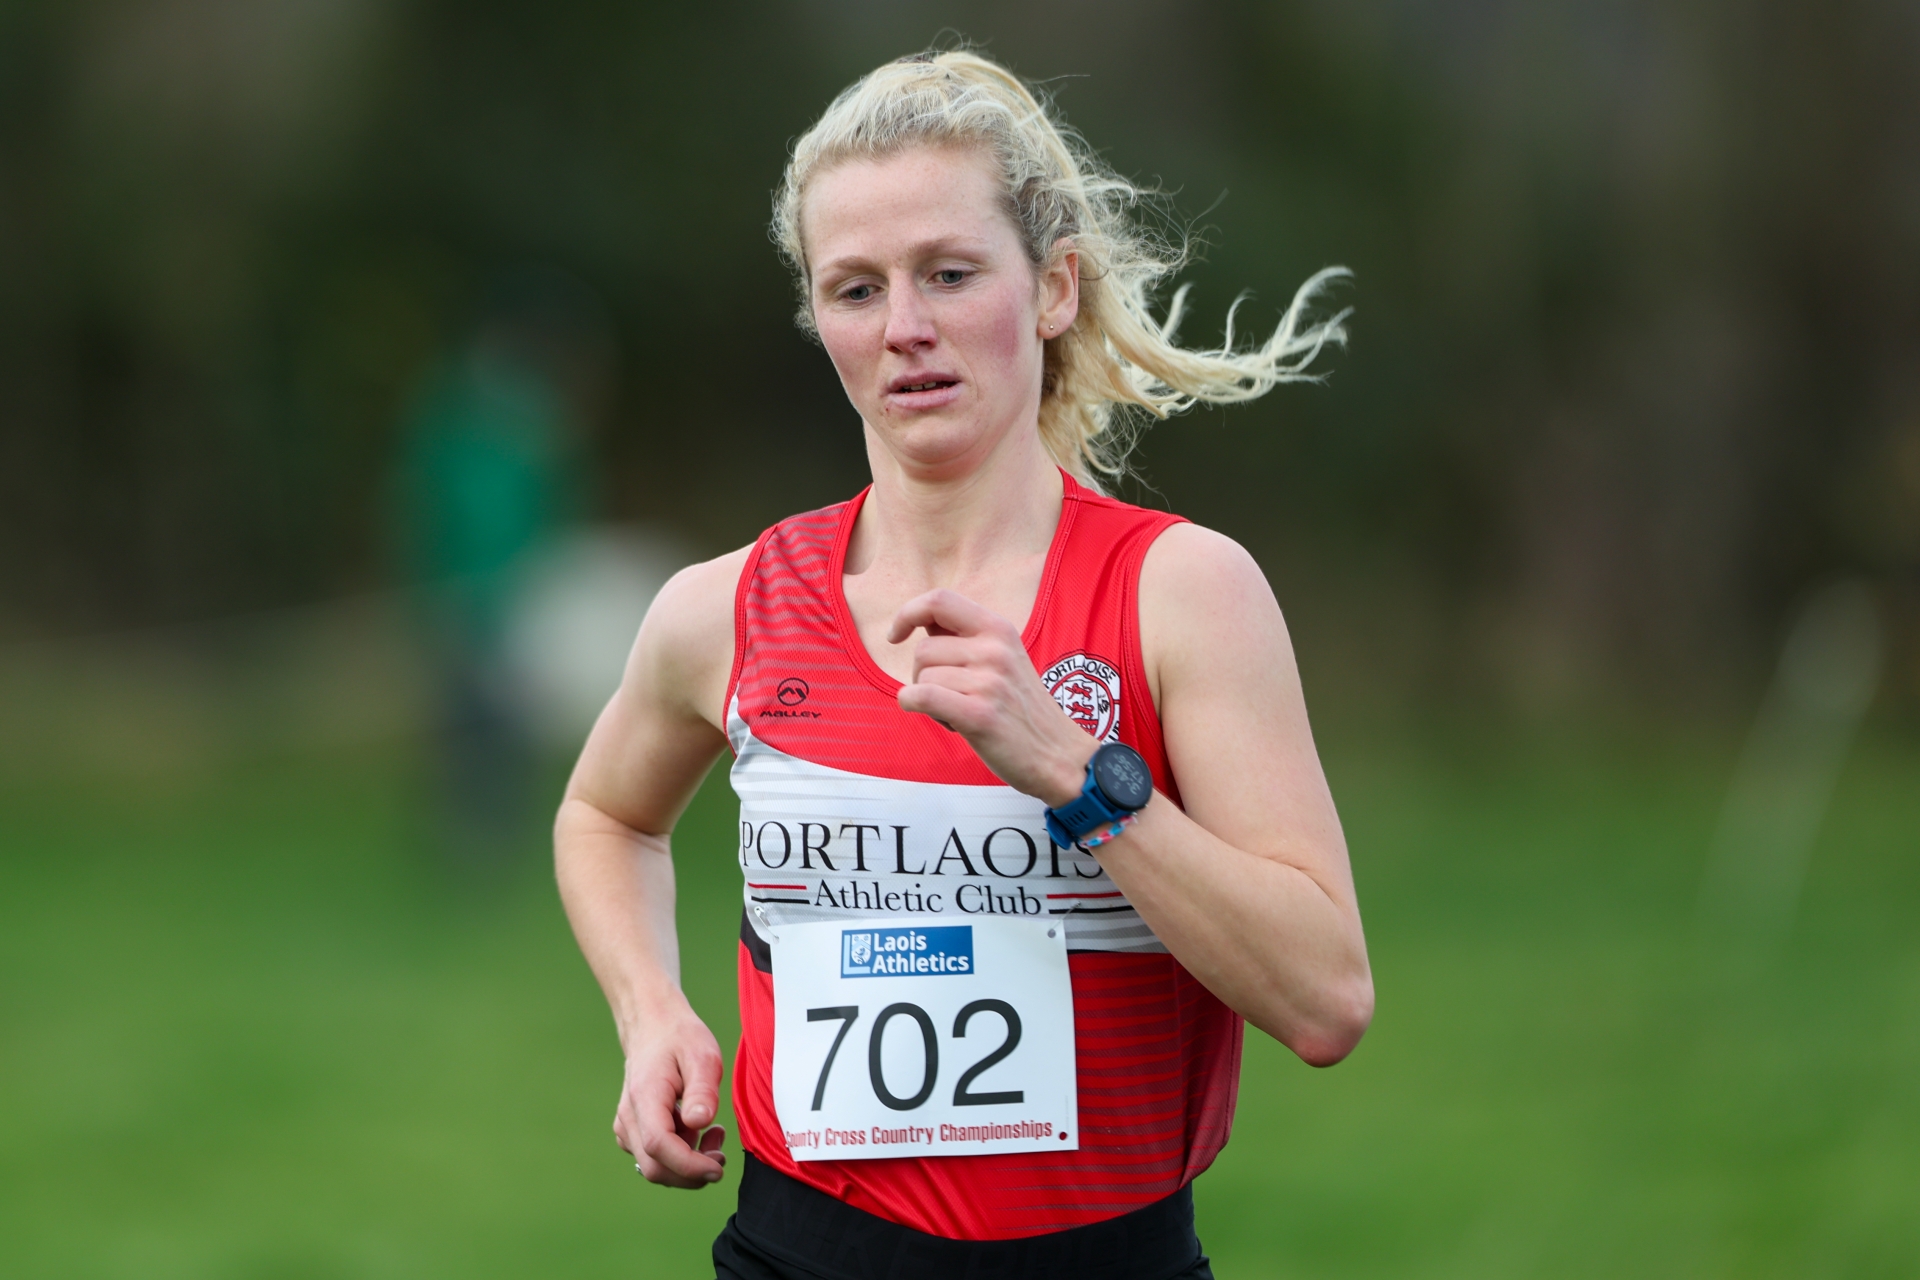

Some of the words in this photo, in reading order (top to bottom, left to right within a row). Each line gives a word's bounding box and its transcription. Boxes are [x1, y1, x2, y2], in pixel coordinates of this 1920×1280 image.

[1112, 763, 1140, 795] 3:48
[814, 879, 943, 913] Athletic
[955, 884, 1041, 915] Club
[874, 930, 927, 952] Laois
[872, 951, 970, 974] Athletics
[807, 998, 1024, 1111] 702
[825, 1127, 866, 1146] Cross
[871, 1125, 934, 1145] Country
[940, 1119, 1052, 1143] Championships
